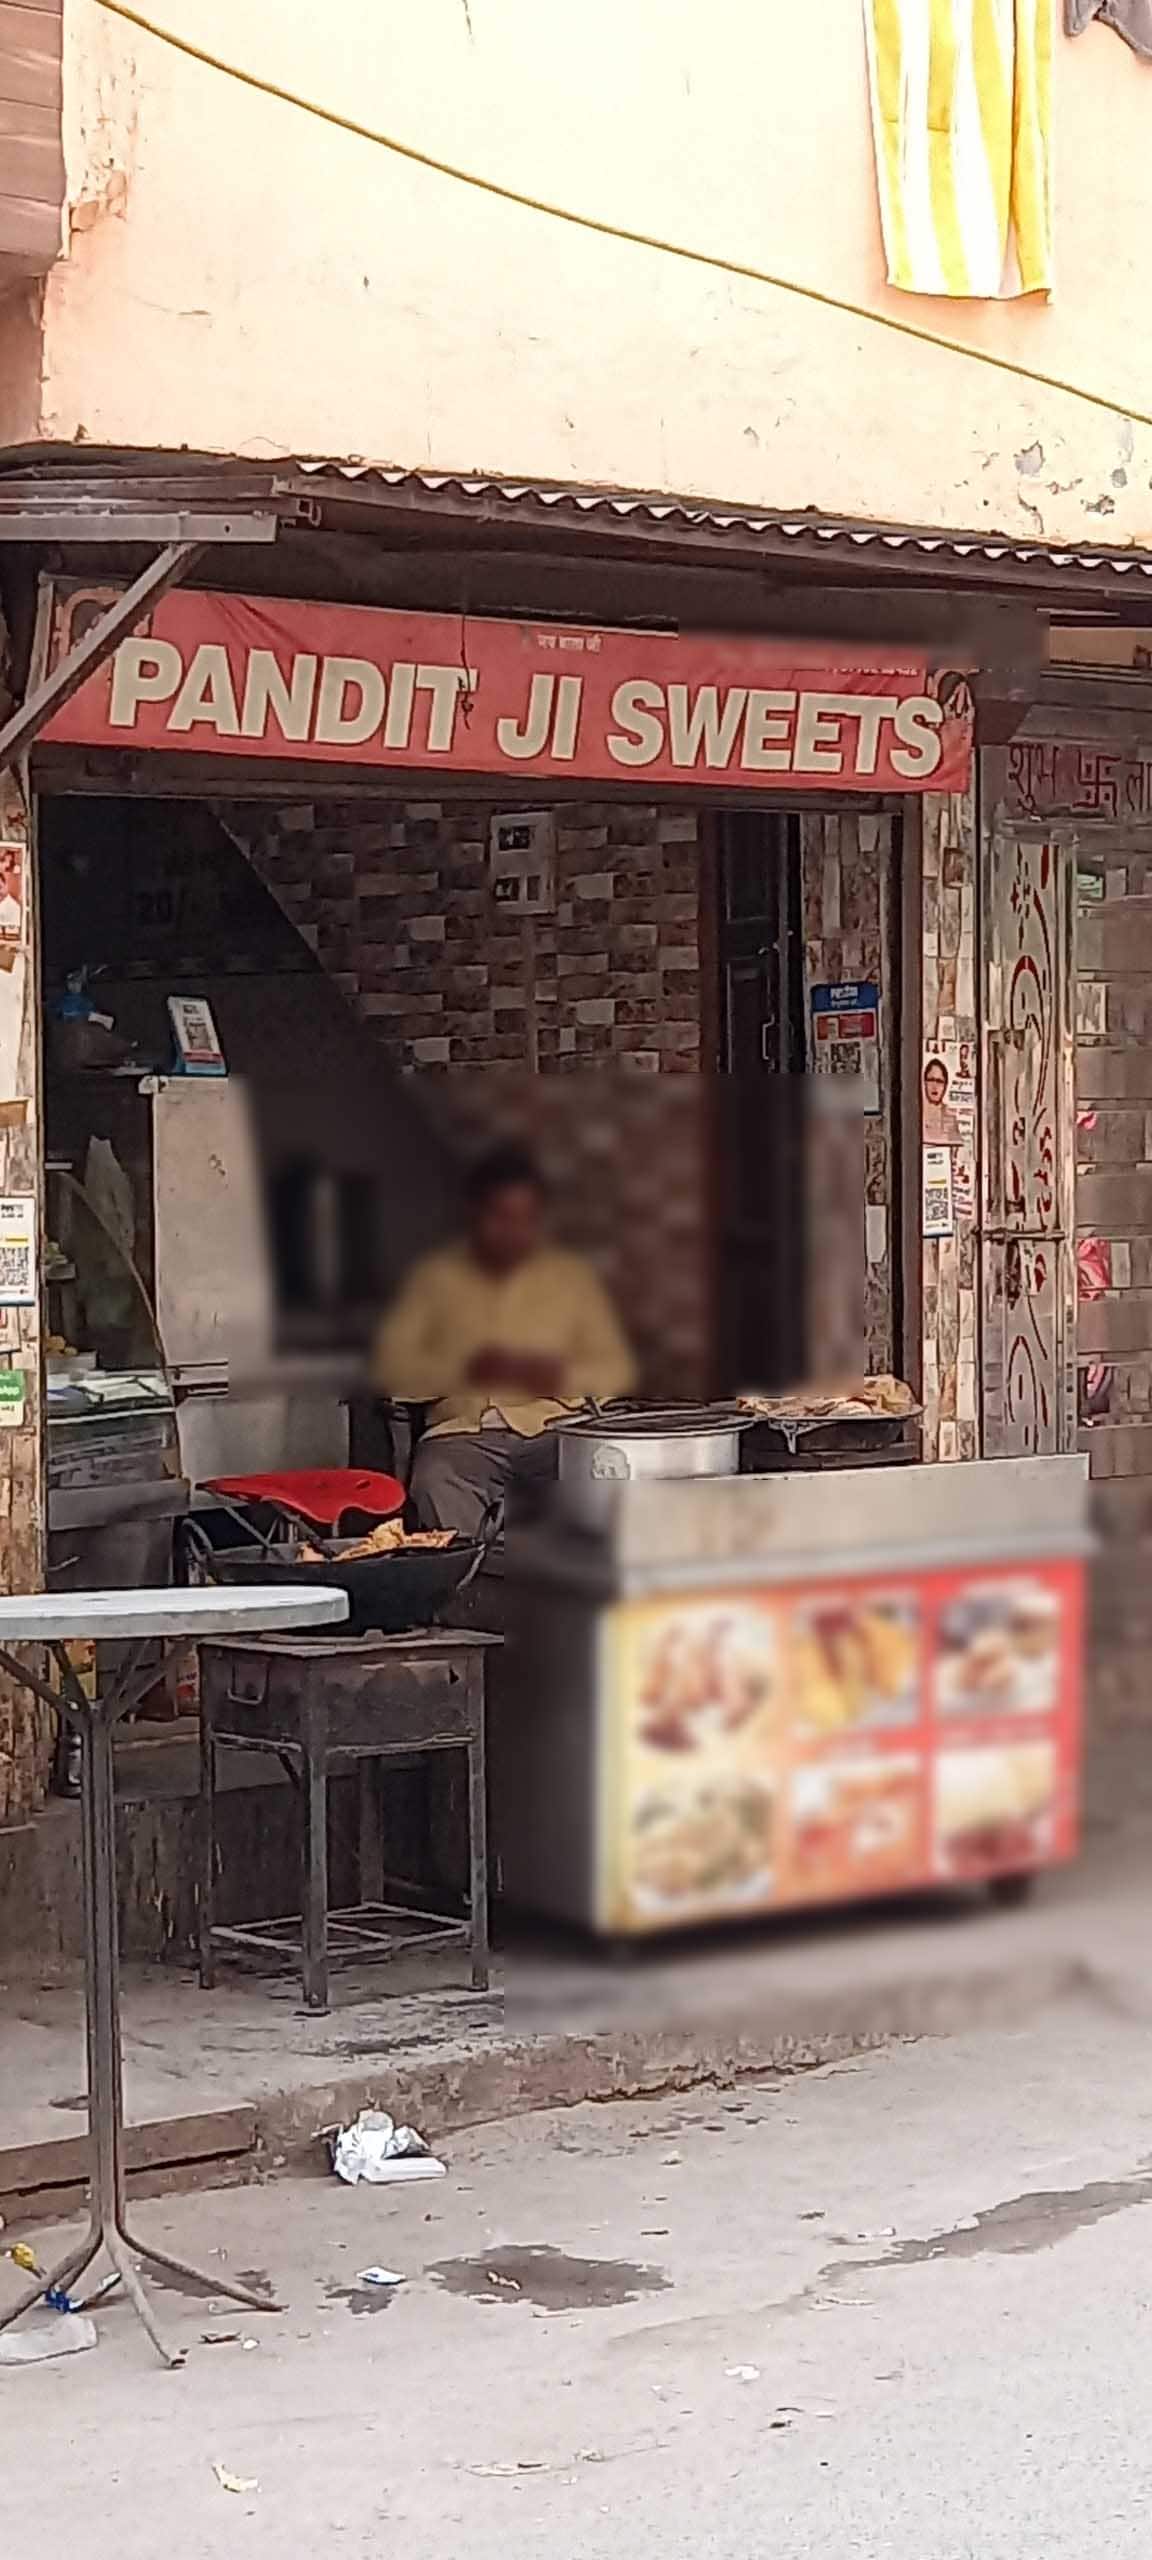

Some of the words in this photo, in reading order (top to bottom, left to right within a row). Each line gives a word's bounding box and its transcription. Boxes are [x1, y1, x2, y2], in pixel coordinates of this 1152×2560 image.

[109, 637, 479, 752] PANDIT
[497, 673, 584, 761] JI
[607, 679, 944, 779] SWEETS
[1008, 742, 1060, 816] शुभ
